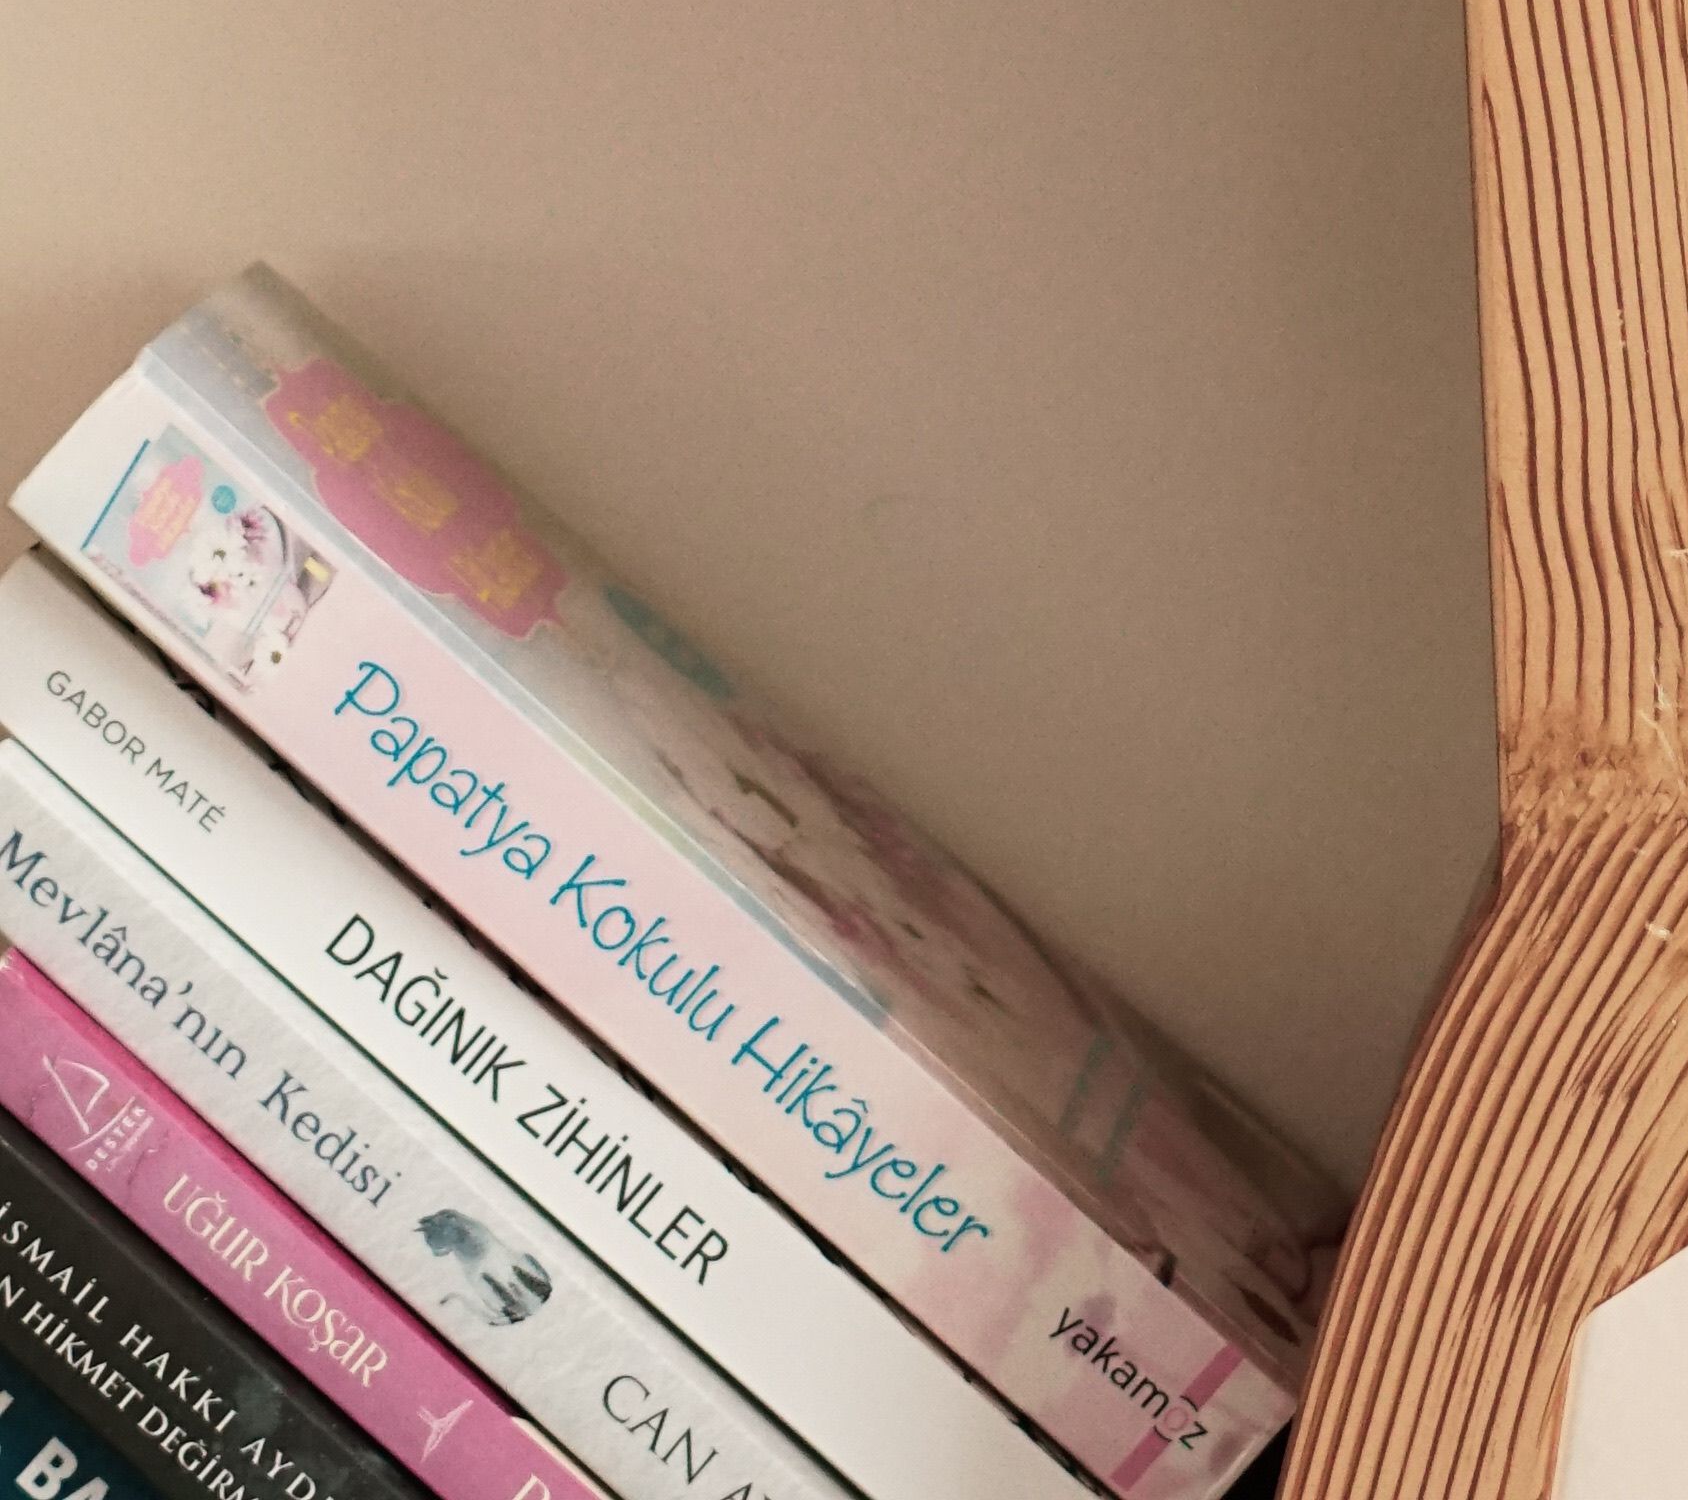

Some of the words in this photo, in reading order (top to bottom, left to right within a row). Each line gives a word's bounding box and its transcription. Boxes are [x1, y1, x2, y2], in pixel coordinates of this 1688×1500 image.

[46, 670, 147, 766] GABOR
[145, 757, 226, 835] MATÉ
[325, 913, 526, 1103] DAĞINIK
[516, 1082, 729, 1285] ZİHİNLER
[335, 661, 551, 878] Papatya
[550, 854, 735, 1043] Kokulu
[731, 1017, 989, 1253] Hikâyeler
[21, 1301, 145, 1411] HİKMET
[163, 1174, 269, 1282] UĞUR
[258, 1069, 402, 1209] Kedisi
[603, 1375, 718, 1485] CAN
[119, 1324, 238, 1433] HAKKI
[240, 1437, 334, 1500] AYD
